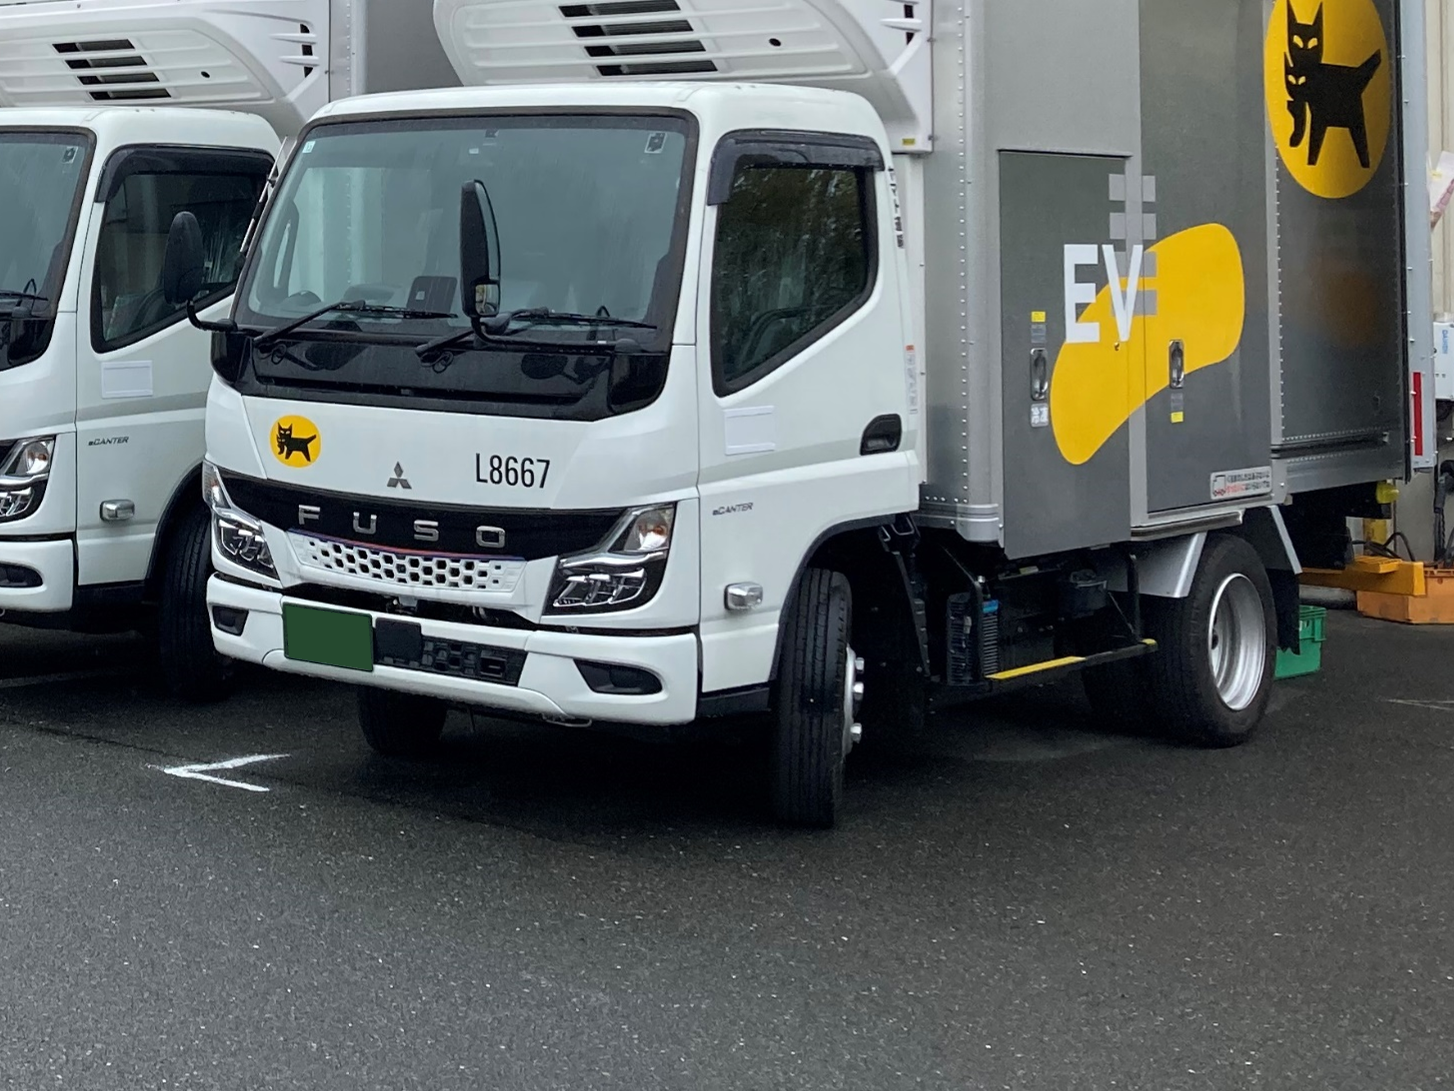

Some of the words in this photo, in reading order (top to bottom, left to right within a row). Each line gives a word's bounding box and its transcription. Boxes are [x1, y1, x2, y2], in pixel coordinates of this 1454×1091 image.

[1064, 244, 1143, 343] EV
[475, 453, 551, 489] L8667
[298, 504, 506, 549] FUSO
